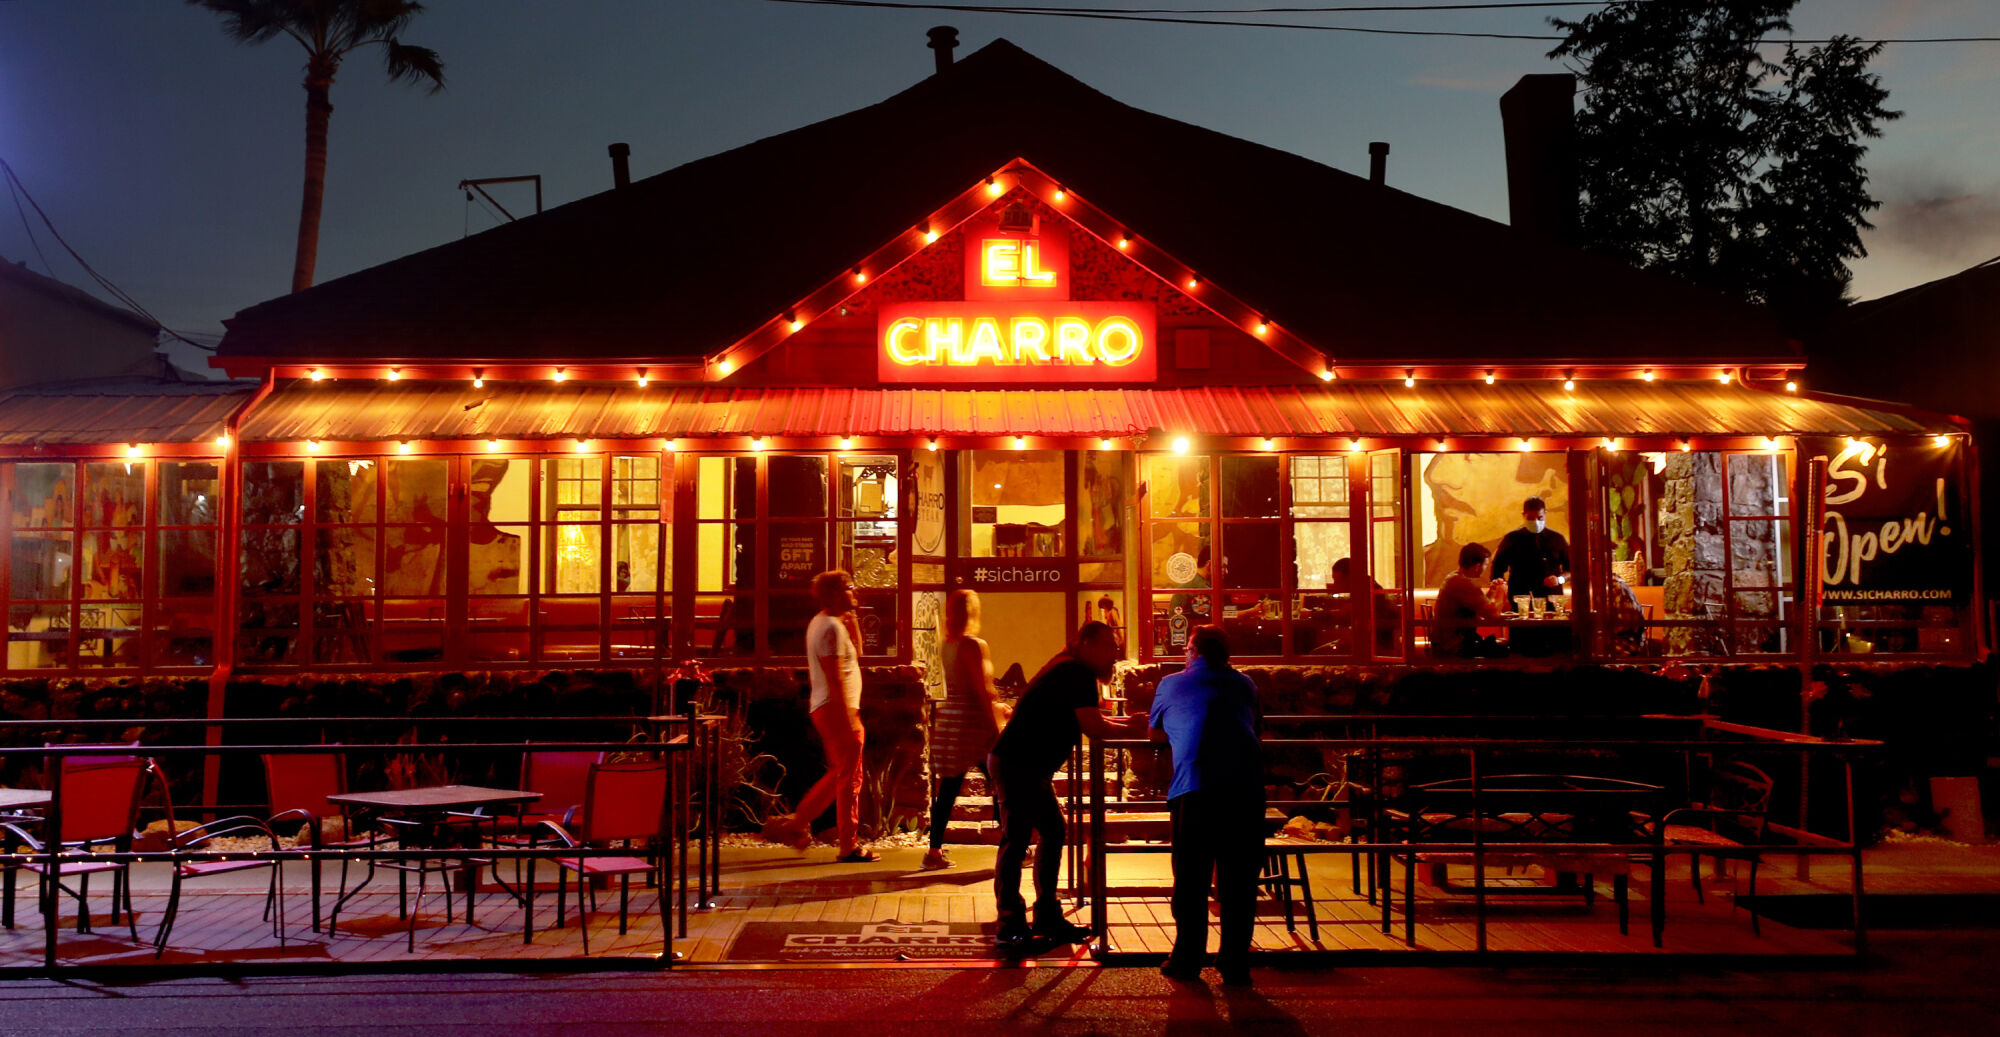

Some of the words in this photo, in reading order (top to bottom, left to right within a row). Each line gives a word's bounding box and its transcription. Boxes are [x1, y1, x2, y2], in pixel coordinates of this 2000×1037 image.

[982, 239, 1057, 287] EL
[885, 315, 1144, 367] CHARRO
[1823, 478, 1952, 585] Open!
[780, 562, 813, 570] APART
[781, 548, 814, 561] 6FT
[974, 566, 1061, 582] #sicharro
